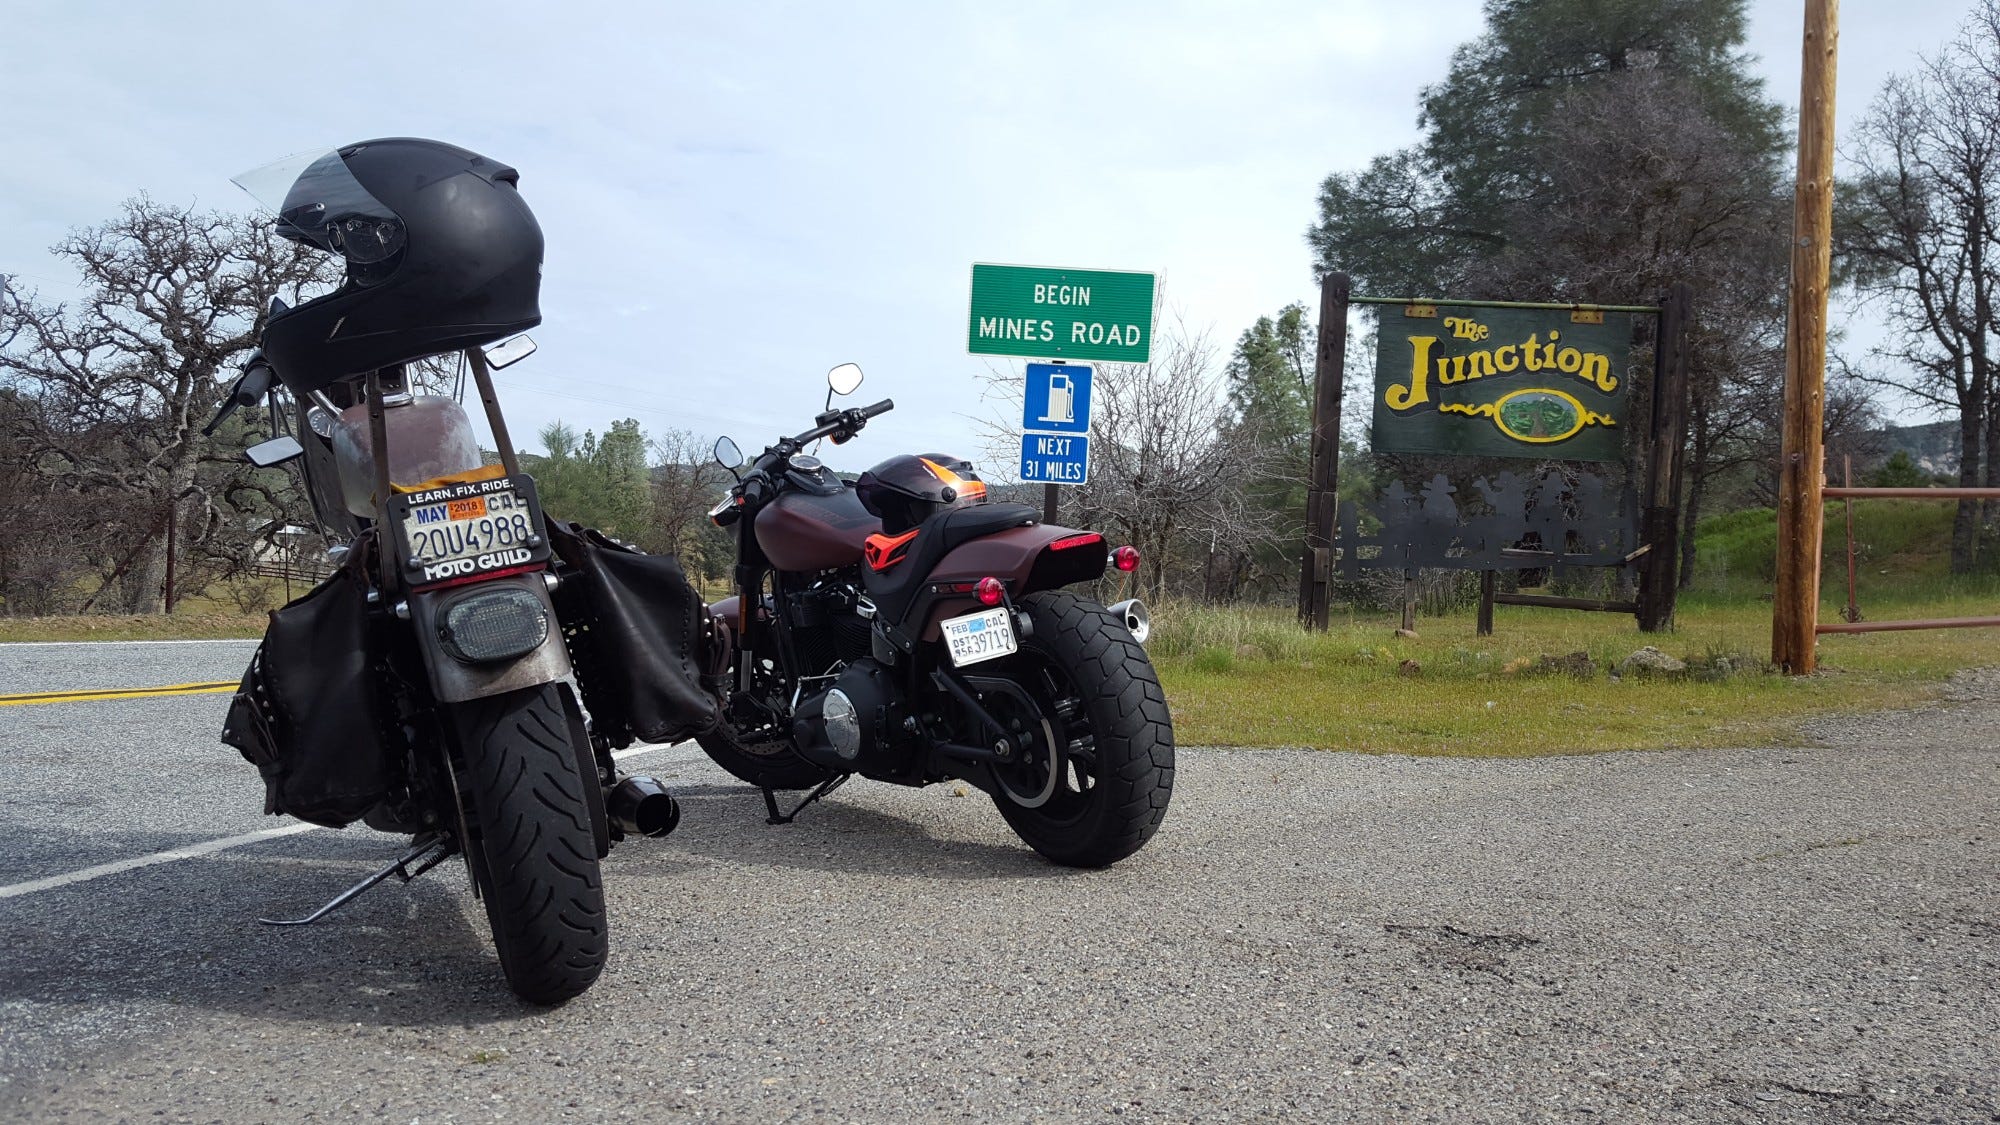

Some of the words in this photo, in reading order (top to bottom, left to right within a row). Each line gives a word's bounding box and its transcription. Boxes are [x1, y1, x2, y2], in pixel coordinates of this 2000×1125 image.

[1034, 284, 1091, 306] BEGIN
[979, 316, 1054, 342] MINES
[1071, 322, 1141, 346] ROAD
[1444, 317, 1489, 341] The
[1384, 330, 1617, 411] Junction
[1037, 437, 1072, 455] NEXT
[1025, 460, 1038, 477] 31
[1046, 461, 1081, 480] MILES
[408, 489, 455, 505] LEARN.
[456, 484, 481, 497] FIX.
[482, 479, 514, 492] RIDE.
[416, 505, 448, 524] MAY
[454, 501, 478, 513] 2018
[488, 494, 527, 511] CAL
[414, 514, 528, 560] 20U4988
[424, 558, 475, 581] MOTO
[478, 548, 532, 570] GUILD
[951, 624, 968, 635] FEB
[985, 616, 1006, 628] CAL
[970, 628, 1009, 653] 39719
